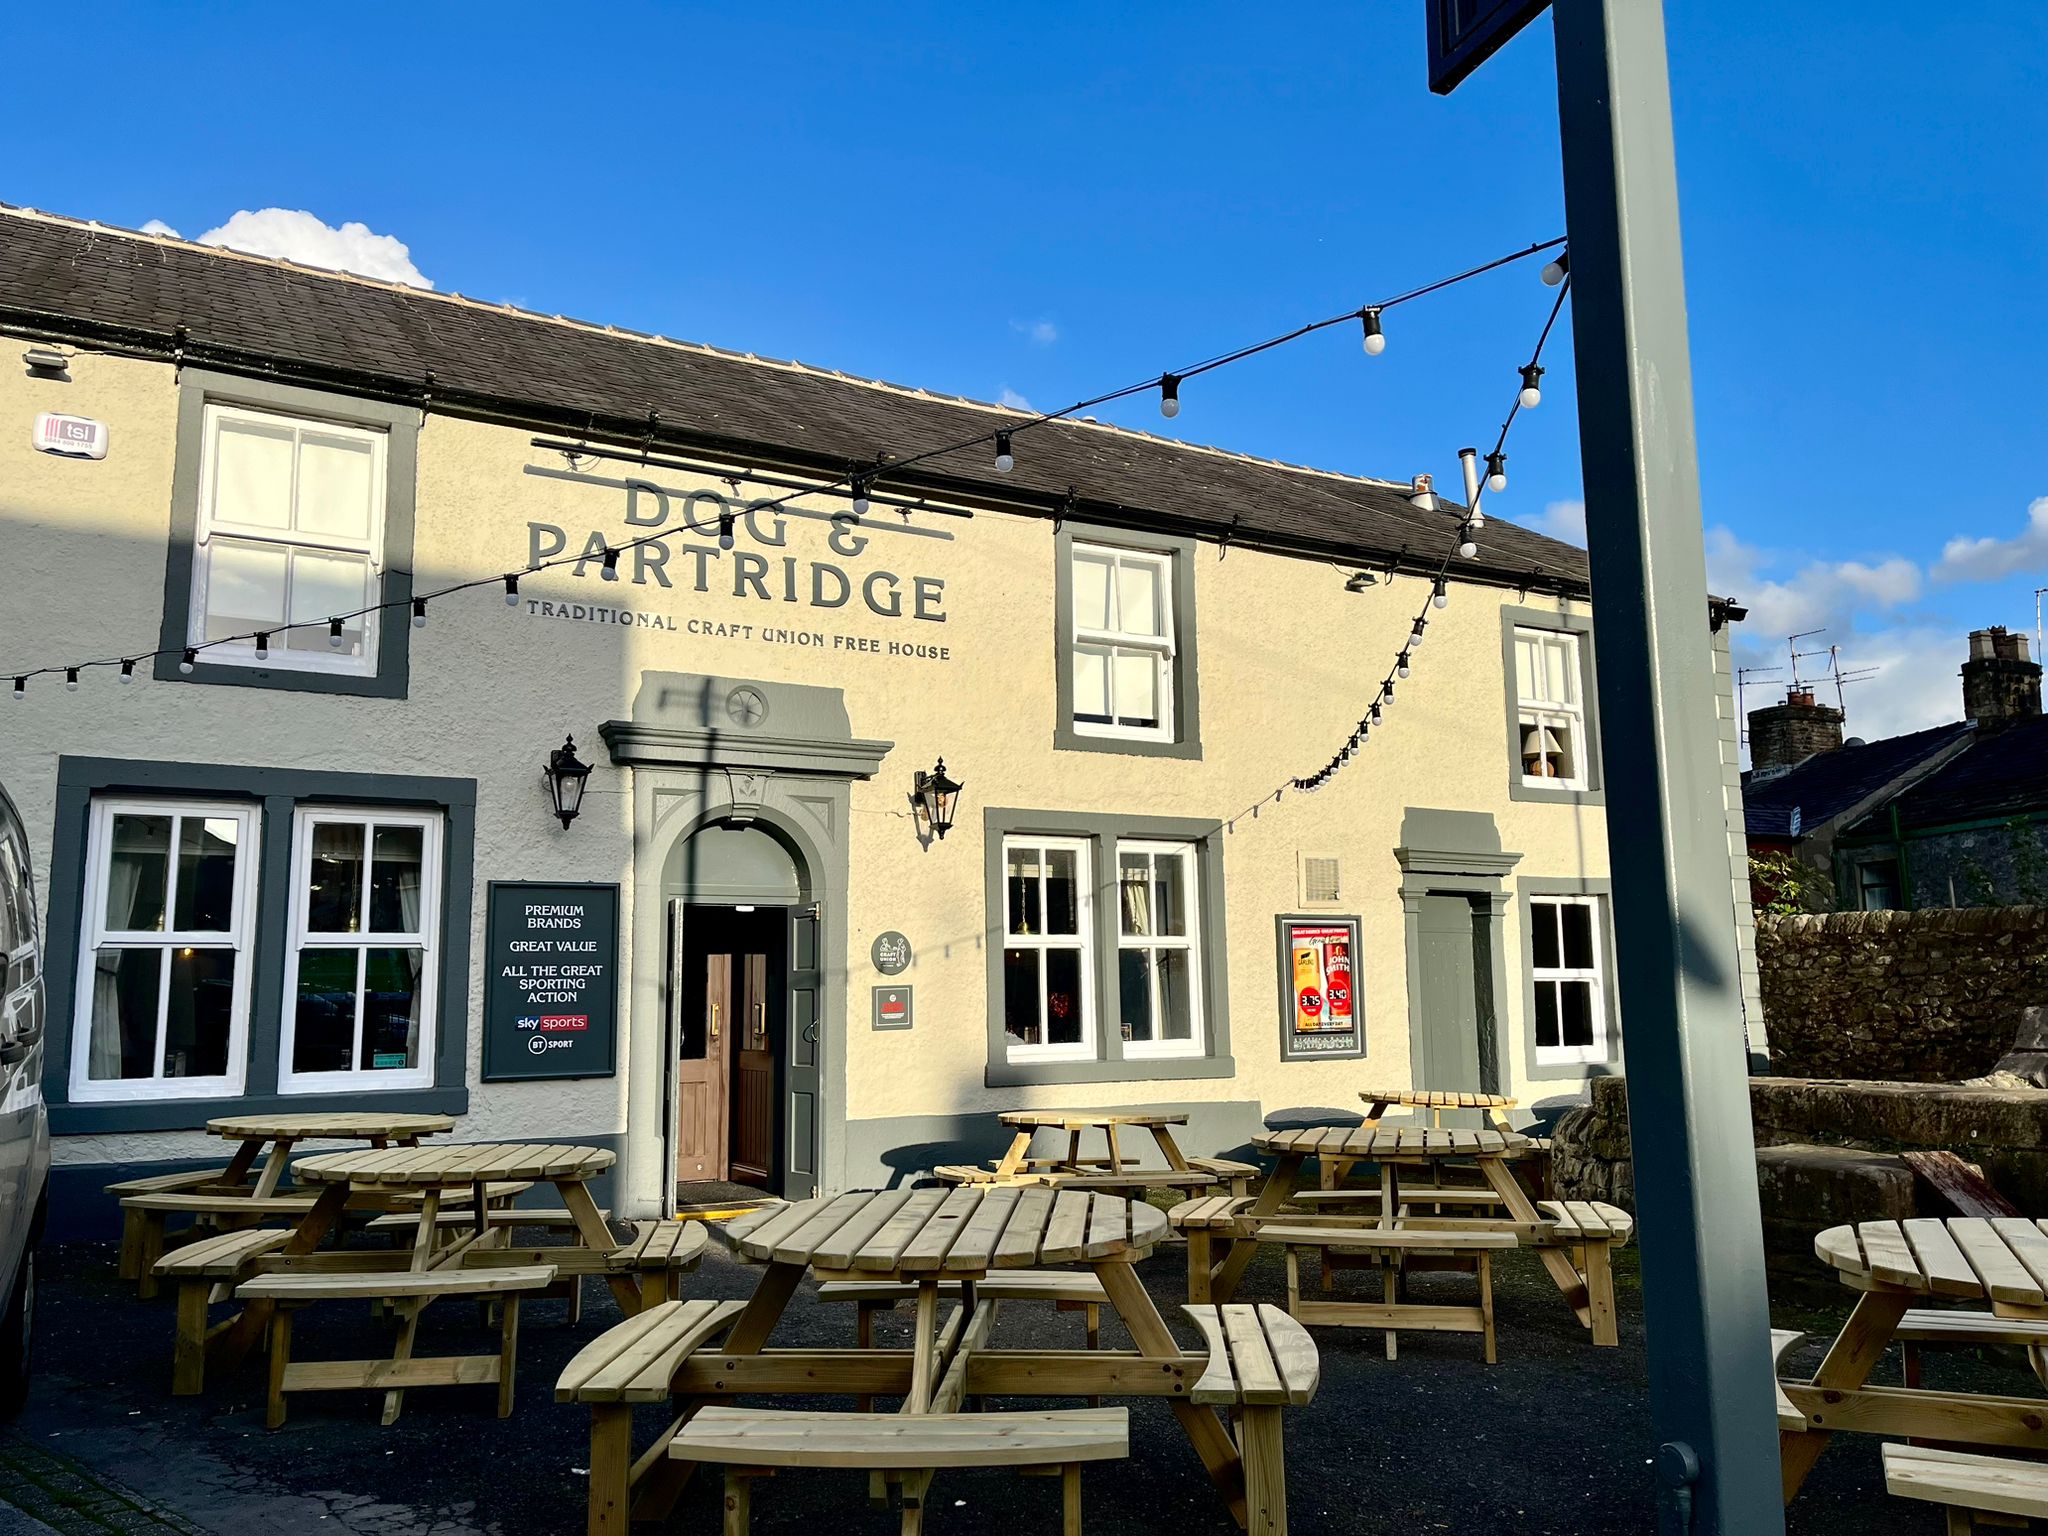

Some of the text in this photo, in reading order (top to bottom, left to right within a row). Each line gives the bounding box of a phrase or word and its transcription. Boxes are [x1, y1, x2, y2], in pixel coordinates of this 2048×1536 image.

[66, 423, 89, 441] tsi
[623, 477, 869, 557] DOG &
[526, 521, 947, 623] PARTRIDGE
[527, 599, 951, 661] TRADITIONAL CRAFT UNION FREE HOUSE
[525, 905, 584, 917] PREMIUM
[527, 917, 582, 929] BRANDS
[509, 941, 598, 952] GREAT VALUE
[1329, 956, 1350, 966] JOHN
[502, 965, 603, 977] ALL THE GREAT
[519, 978, 586, 990] SPORTING
[526, 991, 578, 1003] ACTION
[1329, 989, 1347, 999] 3.40
[1302, 995, 1321, 1006] 3.75
[517, 1016, 585, 1030] sky sports
[532, 1039, 574, 1049] BT SPORT
